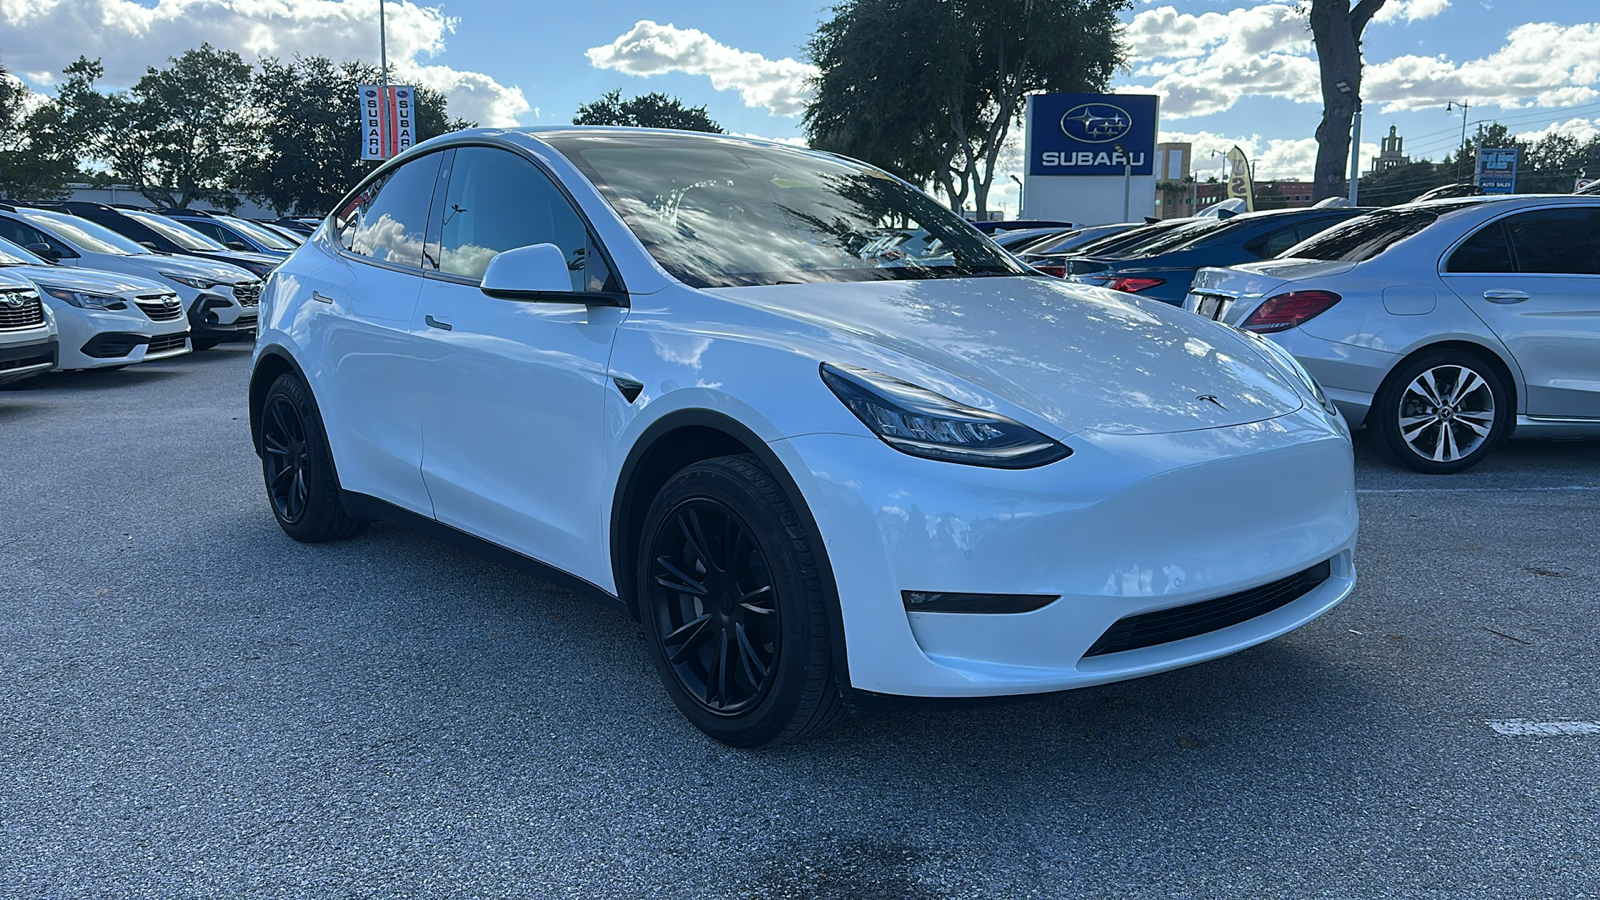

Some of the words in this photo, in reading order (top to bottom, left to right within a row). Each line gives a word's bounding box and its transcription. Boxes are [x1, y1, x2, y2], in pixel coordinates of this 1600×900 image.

[367, 100, 379, 155] SUBARU
[399, 100, 410, 152] SUBAR
[1042, 152, 1145, 166] SUBARU
